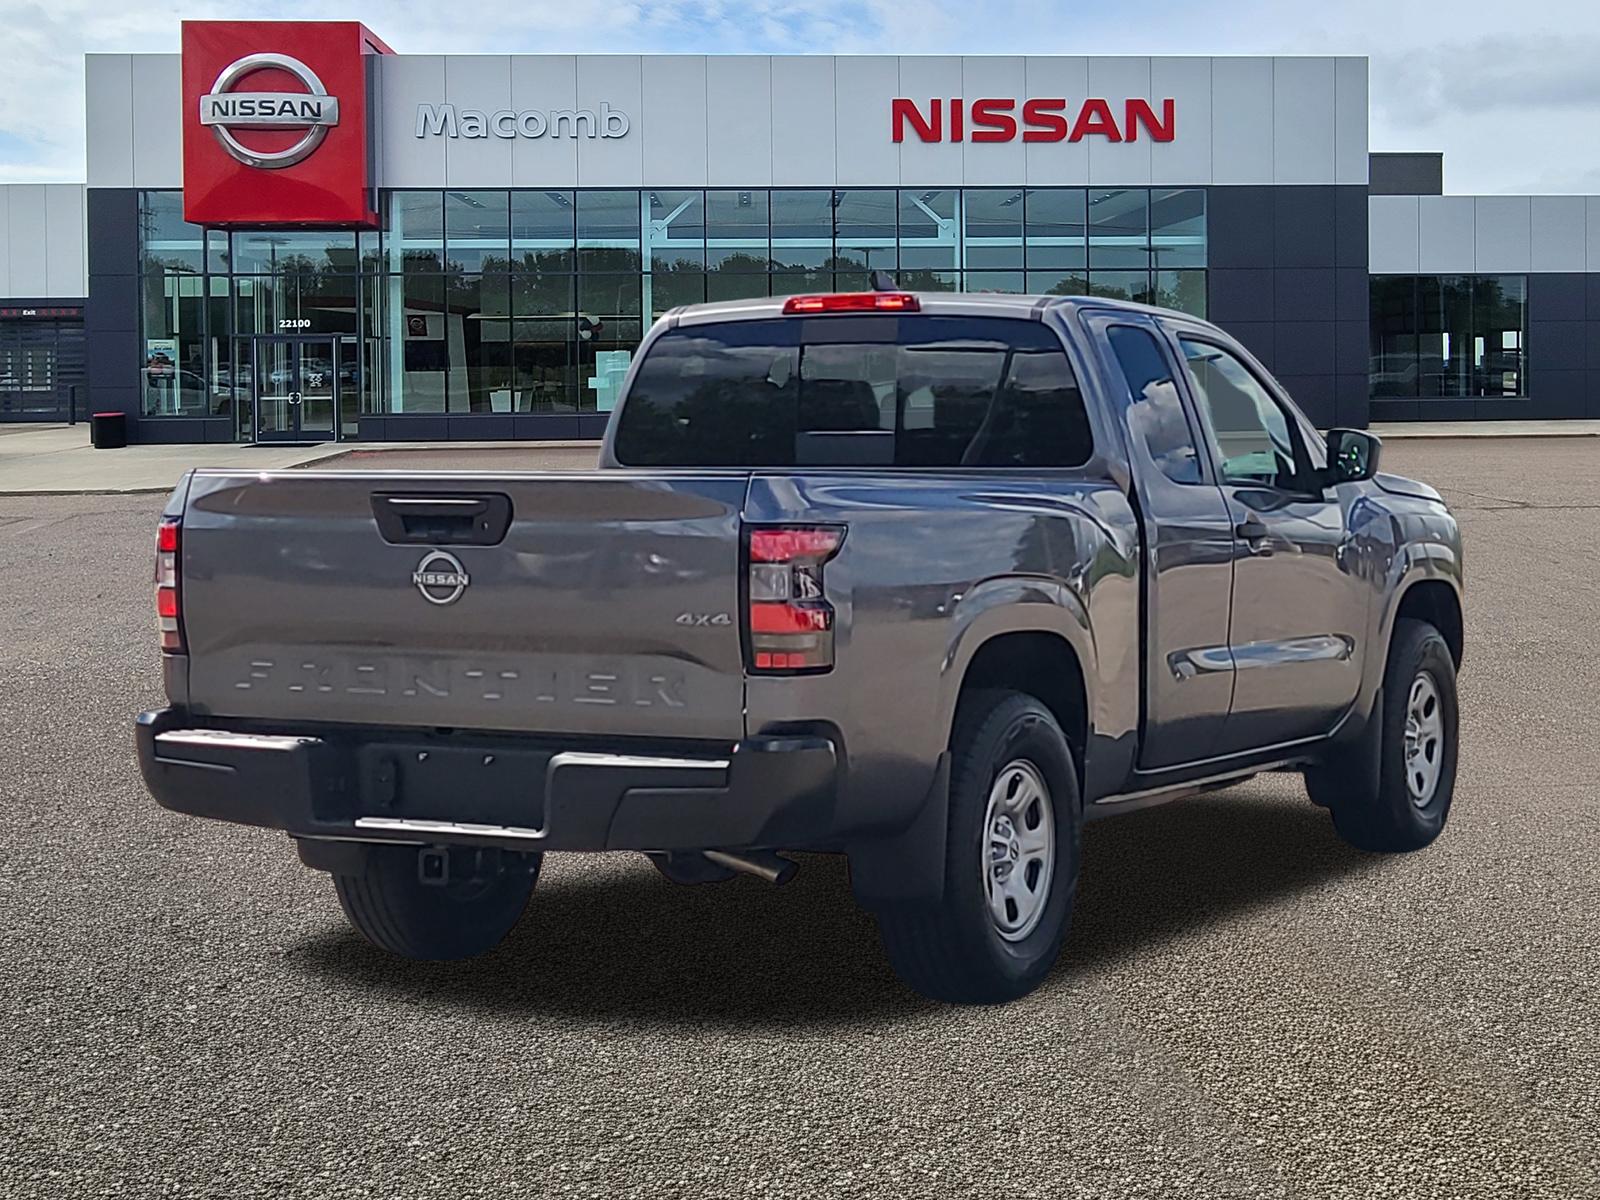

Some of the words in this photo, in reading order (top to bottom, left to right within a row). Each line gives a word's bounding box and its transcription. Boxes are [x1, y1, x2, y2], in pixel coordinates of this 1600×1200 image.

[211, 100, 322, 117] NISSAN
[415, 102, 630, 138] Macomb
[892, 98, 1175, 142] NISSAN
[279, 319, 311, 328] 22100
[413, 572, 469, 586] NISSAN
[234, 660, 687, 707] FRONTIER
